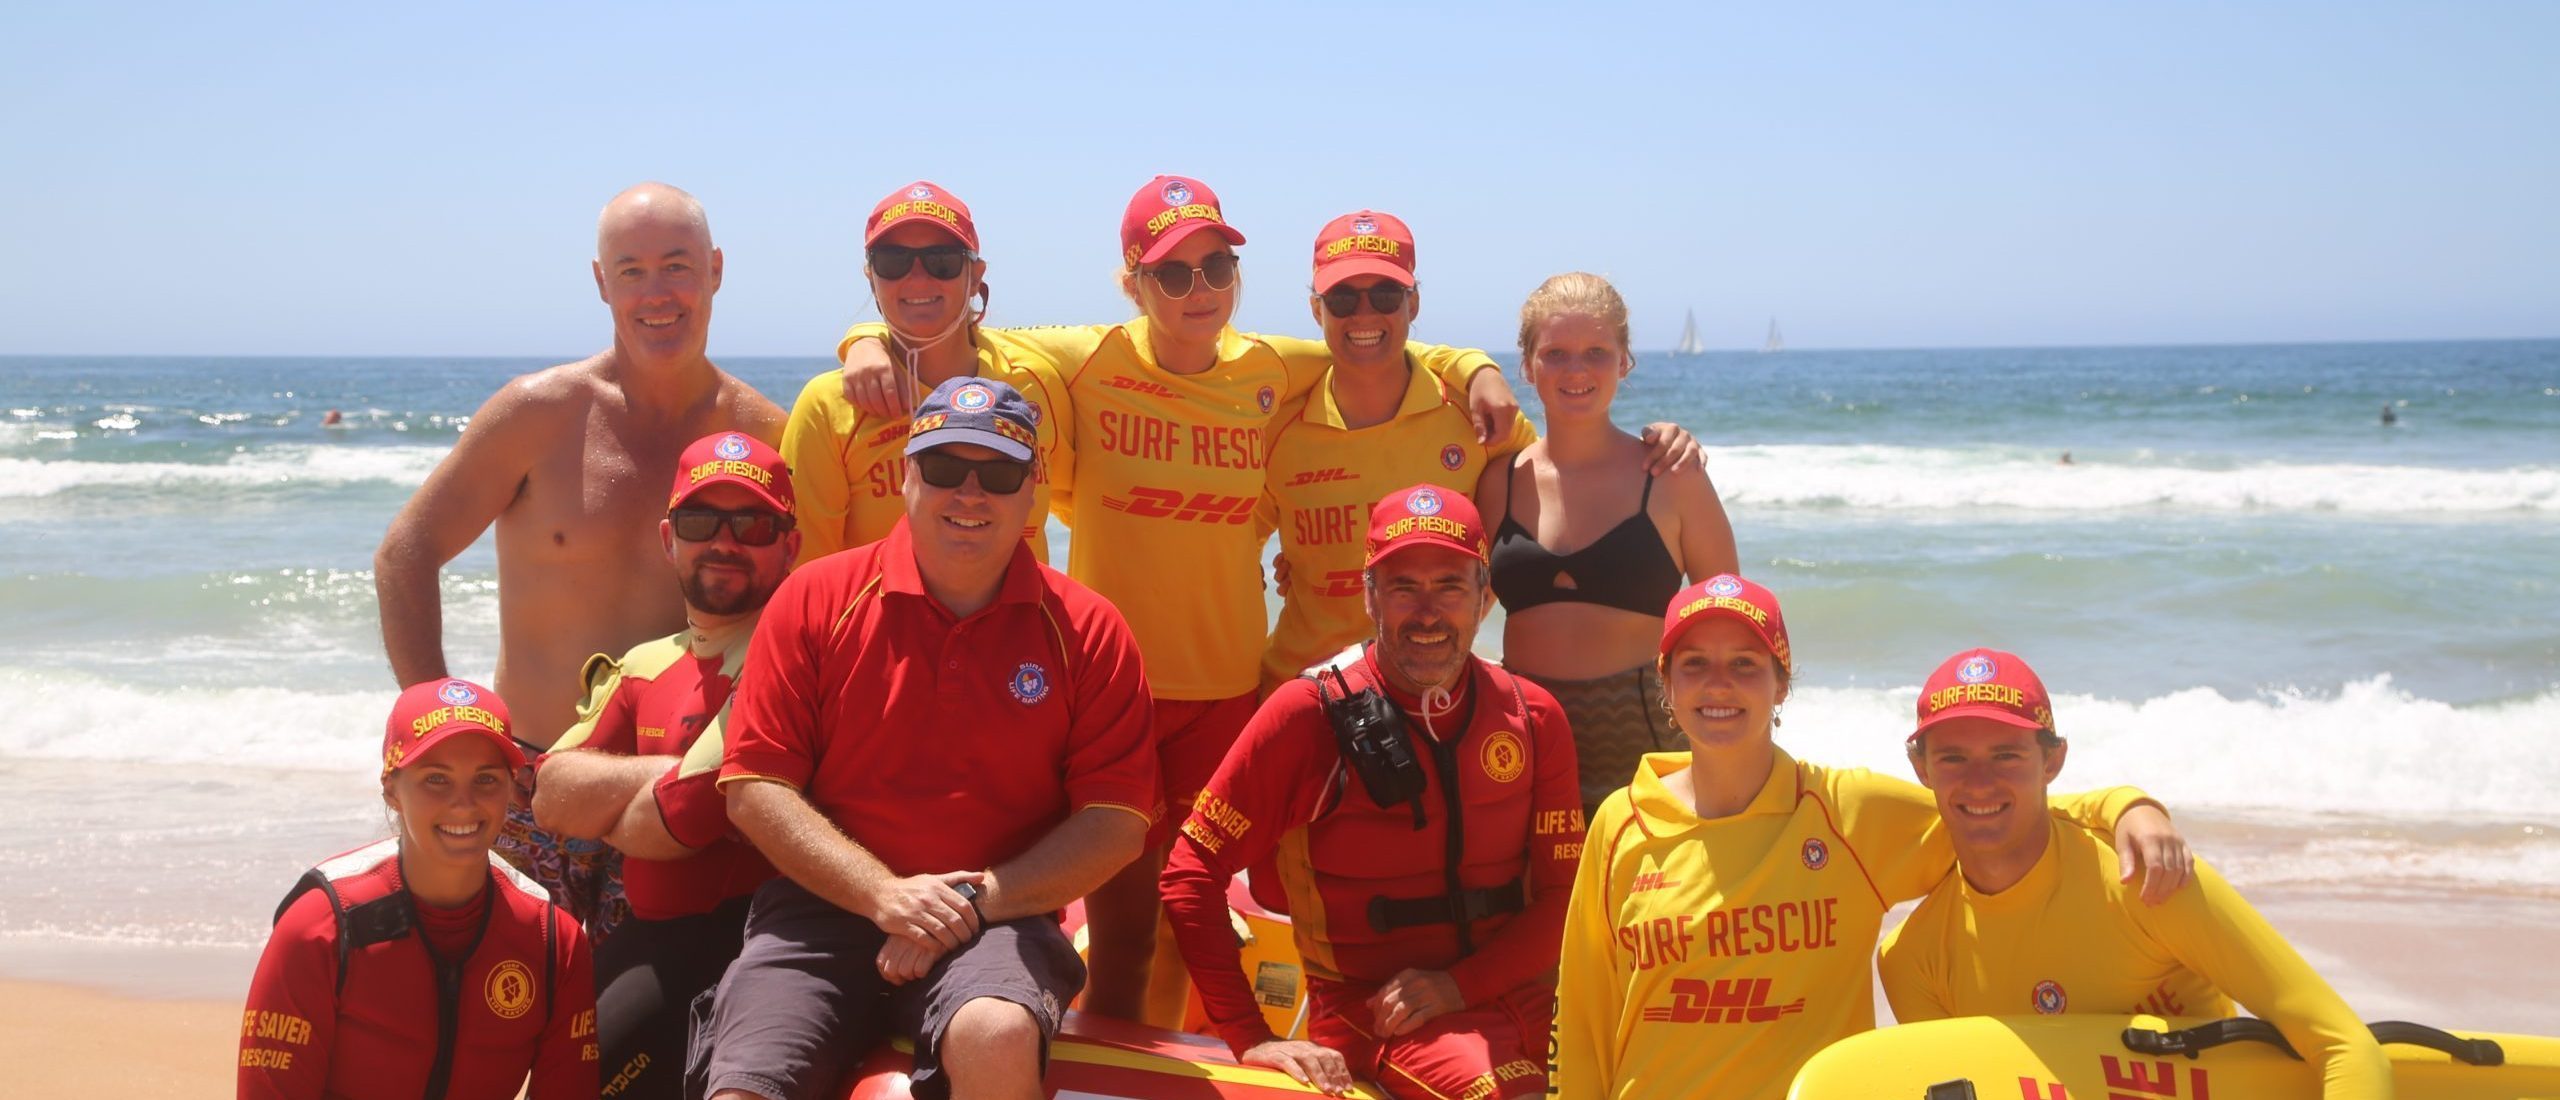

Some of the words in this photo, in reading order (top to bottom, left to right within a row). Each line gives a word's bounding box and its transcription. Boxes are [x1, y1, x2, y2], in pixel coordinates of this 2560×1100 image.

[882, 201, 911, 225] SURF
[913, 200, 958, 226] RESCUE
[1147, 208, 1178, 236] SURF
[1178, 204, 1222, 224] RESCUE
[1327, 236, 1356, 258] SURF
[1357, 234, 1400, 258] RESCUE
[1109, 375, 1176, 399] DHL
[1099, 410, 1181, 462] SURF
[1191, 425, 1266, 470] RESC
[691, 461, 723, 485] SURF
[723, 460, 773, 490] RESCUE
[868, 456, 906, 498] SU
[1291, 467, 1352, 488] DHL
[1294, 504, 1358, 546] SURF
[1385, 516, 1417, 541] SURF
[1418, 515, 1467, 541] RESCUE
[1680, 596, 1712, 620] SURF
[1714, 596, 1768, 628] RESCUE
[1930, 686, 1965, 713] SURF
[1966, 683, 2023, 708] RESCUE
[413, 706, 452, 738] SURF
[454, 705, 505, 733] RESCUE
[1205, 797, 1252, 840] SAVER
[1535, 810, 1566, 835] LIFE
[1554, 843, 1583, 861] RESC
[1619, 915, 1694, 971] SURF
[1707, 898, 1838, 957] RESCUE
[1668, 978, 1785, 1024] DHL
[256, 1010, 312, 1046] SAVER
[240, 1048, 293, 1070] RESCUE
[601, 1052, 651, 1097] SURF
